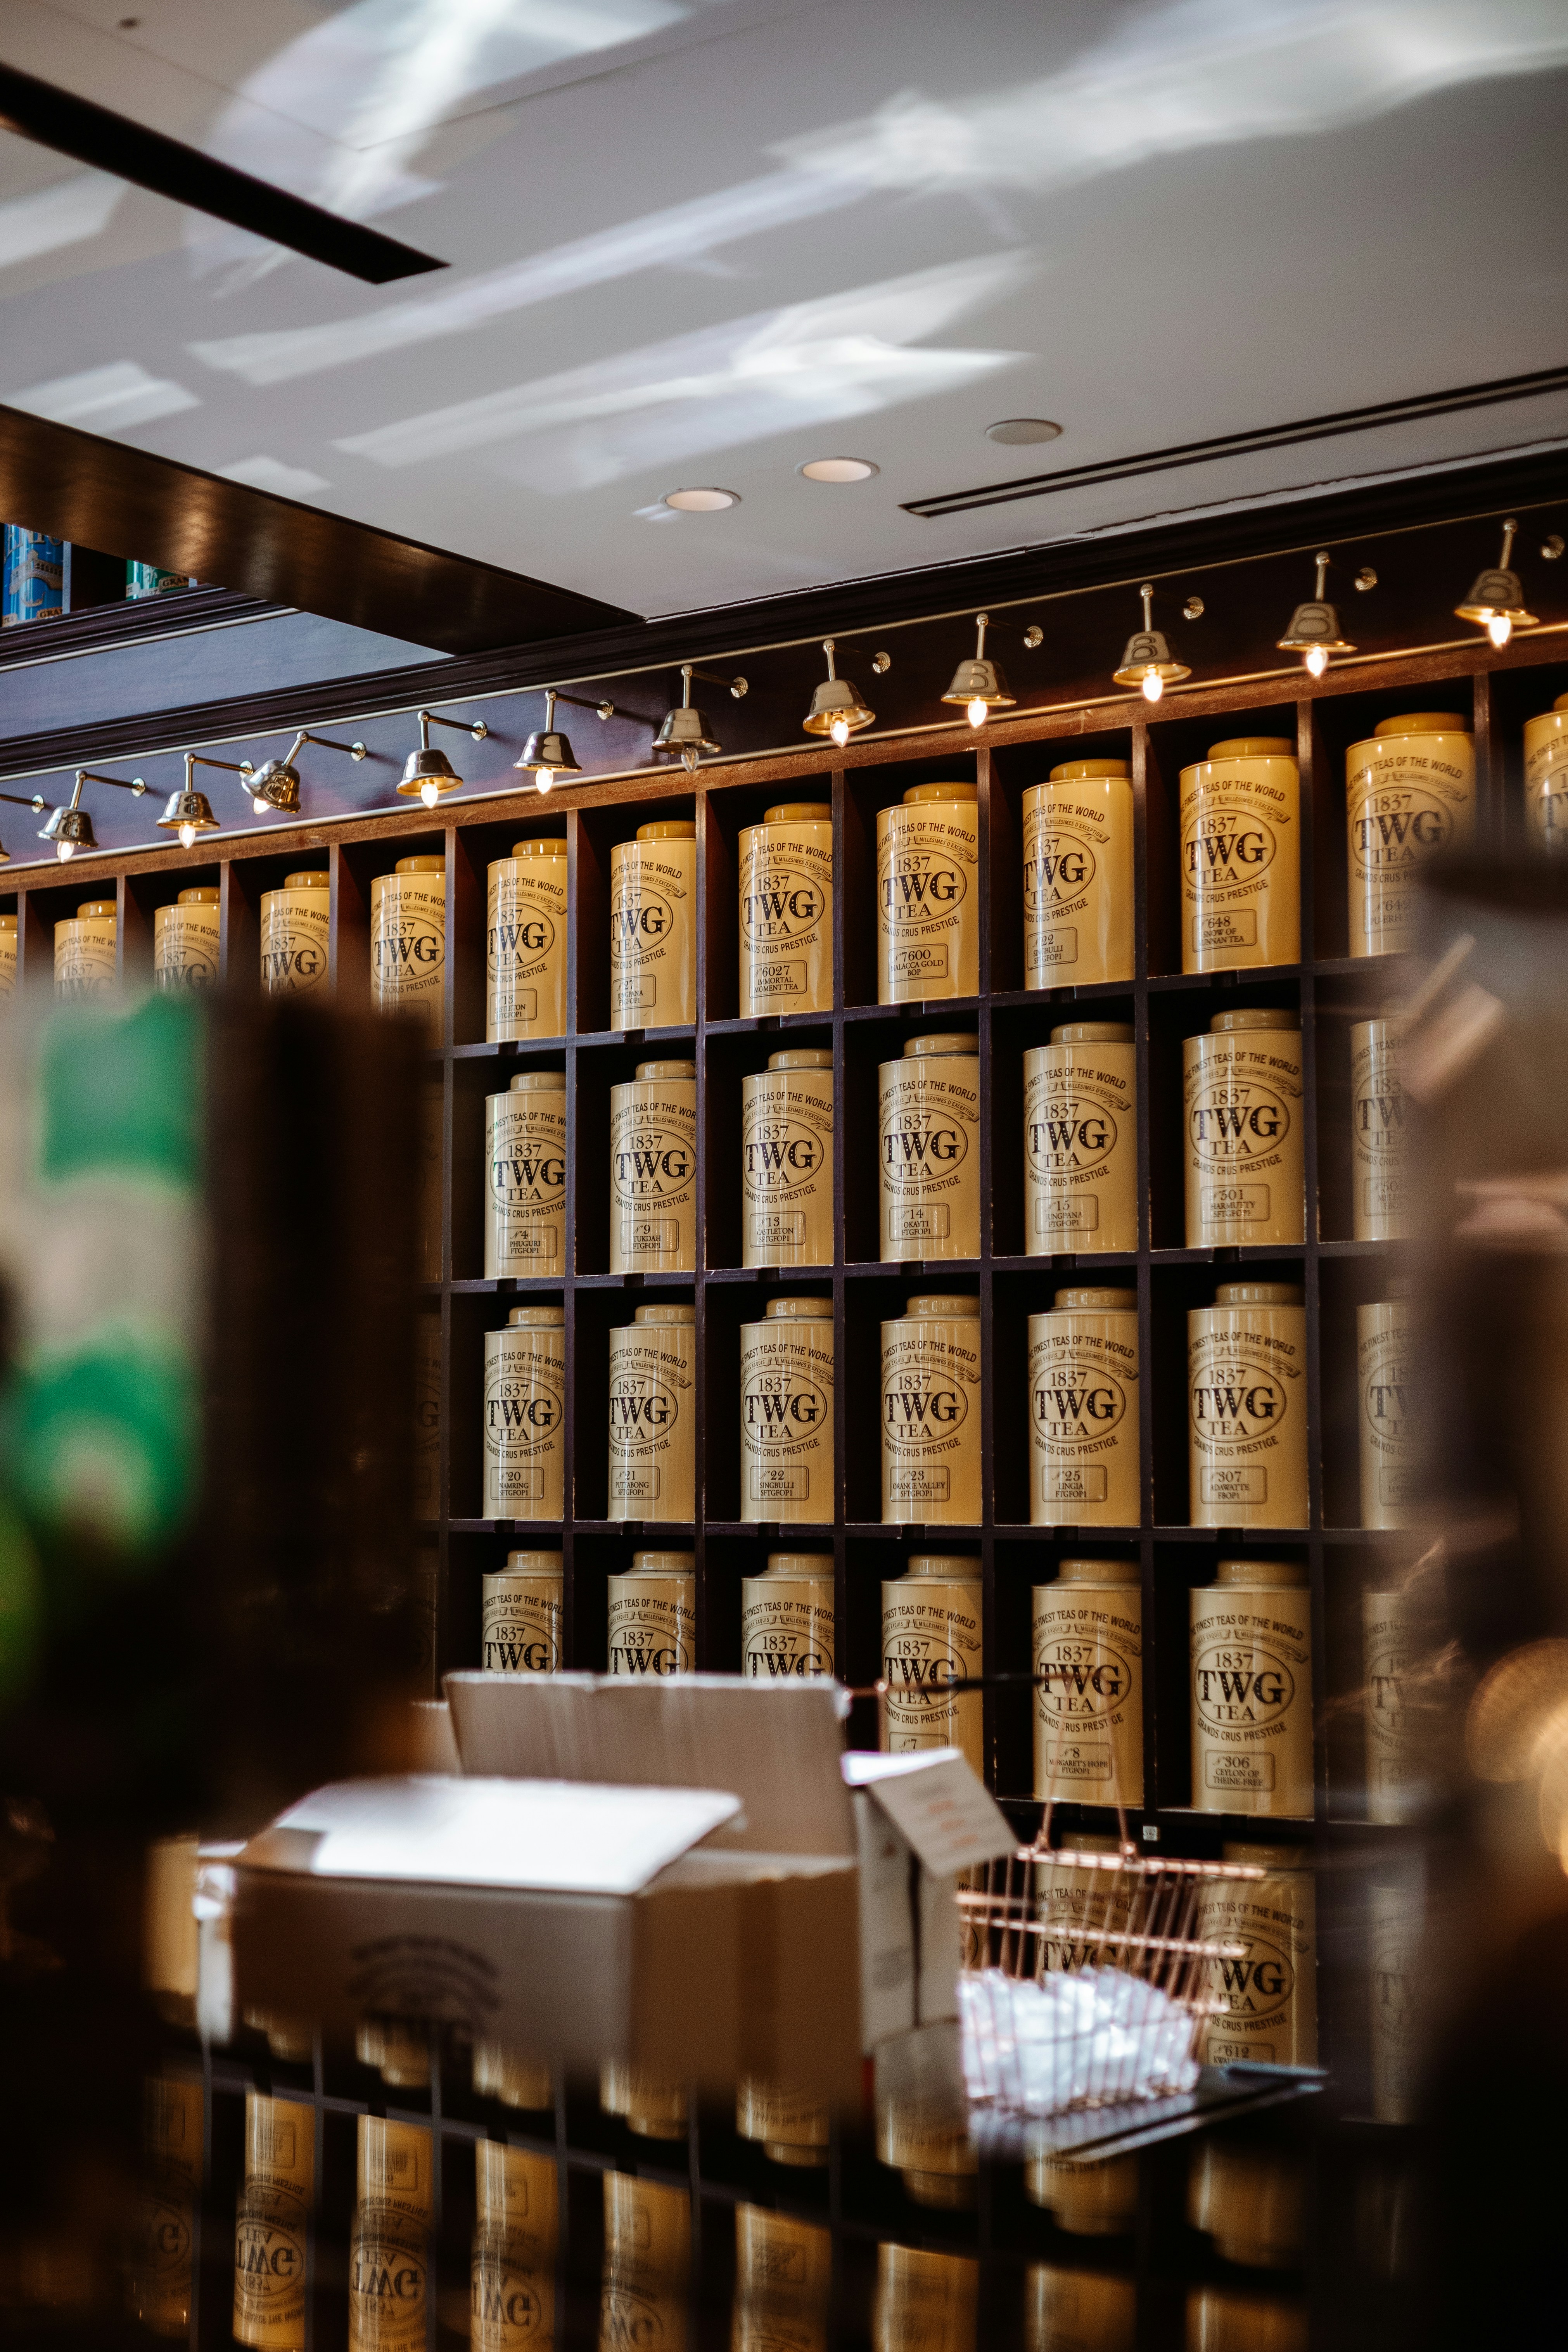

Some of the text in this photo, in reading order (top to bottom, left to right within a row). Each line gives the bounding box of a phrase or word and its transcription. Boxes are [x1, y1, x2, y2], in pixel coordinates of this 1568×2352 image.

[1235, 781, 1285, 801] THE WORLD
[1373, 793, 1412, 813] 1837
[898, 822, 975, 843] TEAS OF THE WORLD
[1201, 817, 1236, 835] 1837
[1356, 810, 1444, 851] TWG
[1031, 838, 1060, 857] 1837
[1186, 832, 1267, 872] TWG
[1372, 845, 1416, 863] TEA
[897, 856, 931, 873] 1837
[1023, 853, 1087, 892] TWG
[757, 875, 790, 892] 1837
[1199, 866, 1239, 884] TEA
[883, 871, 958, 906] TWG
[1031, 887, 1062, 904] TEA
[1227, 879, 1269, 900] PRESTIGE
[414, 893, 428, 902] THE
[617, 893, 641, 909] 1837
[295, 908, 308, 917] THE
[744, 890, 817, 925] TWG
[895, 903, 932, 919] TEA
[1052, 898, 1088, 920] PRESTIGE
[186, 923, 199, 931] THE
[386, 922, 415, 936] 1837
[611, 906, 666, 941] TWG
[755, 921, 792, 936] TEA
[921, 916, 959, 935] PRESTIGE
[93, 936, 105, 944] THE
[271, 937, 296, 950] 1837
[488, 922, 547, 955] TWG
[616, 937, 643, 952] TEA
[782, 933, 818, 951] PRESTIGE
[375, 936, 440, 966] TWG
[494, 952, 524, 967] TEA
[634, 948, 666, 967] PRESTIGE
[262, 950, 318, 979] TWG
[384, 964, 416, 977] TEA
[515, 963, 547, 980] PRESTIGE
[406, 976, 440, 992] PRESTIGE
[754, 985, 782, 993] MOMENT
[757, 977, 793, 985] IMMORTAL
[1212, 1088, 1250, 1104] 1837
[1044, 1103, 1079, 1119] 1837
[898, 1114, 931, 1130] 1837
[1193, 1105, 1280, 1140] TWG
[758, 1124, 789, 1140] 1837
[1029, 1119, 1108, 1154] TWG
[508, 1143, 542, 1157] 1837
[630, 1135, 663, 1149] 1837
[884, 1130, 960, 1163] TWG
[1210, 1140, 1252, 1155] TEA
[746, 1140, 815, 1172] TWG
[1042, 1152, 1082, 1167] TEA
[1240, 1154, 1282, 1173] PRESTIGE
[494, 1159, 565, 1188] TWG
[616, 1150, 689, 1180] TWG
[896, 1162, 934, 1177] TEA
[756, 1171, 790, 1185] TEA
[1070, 1166, 1110, 1185] PRESTIGE
[628, 1180, 664, 1193] TEA
[780, 1184, 816, 1202] PRESTIGE
[923, 1175, 961, 1194] PRESTIGE
[507, 1188, 543, 1200] TEA
[653, 1193, 690, 1210] PRESTIGE
[759, 1377, 791, 1392] 1837
[898, 1375, 931, 1390] 1837
[1051, 1371, 1087, 1387] 1837
[1209, 1368, 1245, 1385] 1837
[500, 1384, 529, 1397] 1837
[618, 1380, 645, 1394] 1837
[610, 1396, 670, 1424] TWG
[745, 1394, 819, 1423] TWG
[885, 1392, 959, 1422] TWG
[1036, 1389, 1117, 1420] TWG
[1194, 1387, 1277, 1418] TWG
[488, 1399, 554, 1426] TWG
[497, 1428, 530, 1441] TEA
[616, 1426, 646, 1439] TEA
[757, 1425, 794, 1438] TEA
[897, 1424, 934, 1437] TEA
[1049, 1422, 1090, 1435] TEA
[1207, 1421, 1249, 1435] TEA
[520, 1441, 555, 1457] PRESTIGE
[637, 1439, 671, 1456] PRESTIGE
[745, 1438, 819, 1457] GRANDS CRUS PRESTIGE
[923, 1437, 961, 1456] PRESTIGE
[1079, 1436, 1119, 1455] PRESTIGE
[1237, 1435, 1279, 1454] PRESTIGE
[497, 1595, 539, 1606] TEAS THE
[624, 1599, 695, 1620] TEAS OF THE WORLD
[496, 1627, 525, 1641] 1837
[623, 1631, 654, 1646] 1837
[763, 1636, 797, 1651] 1837
[897, 1641, 930, 1656] 1837
[485, 1642, 550, 1670] TWG
[611, 1647, 680, 1676] TWG
[1056, 1646, 1092, 1662] 1837
[1215, 1652, 1253, 1669] 1837
[748, 1652, 825, 1681] TWG
[885, 1657, 958, 1687] TWG
[1040, 1663, 1122, 1695] TWG
[1198, 1670, 1285, 1703] TWG
[895, 1690, 932, 1705] TEA
[1054, 1697, 1095, 1712] TEA
[921, 1706, 959, 1723] PRESTIGE
[1213, 1705, 1256, 1721] TEA
[1244, 1722, 1287, 1741] PRESTIGE
[1252, 1904, 1270, 1918] THE
[1245, 2015, 1287, 2032] PRESTIGE
